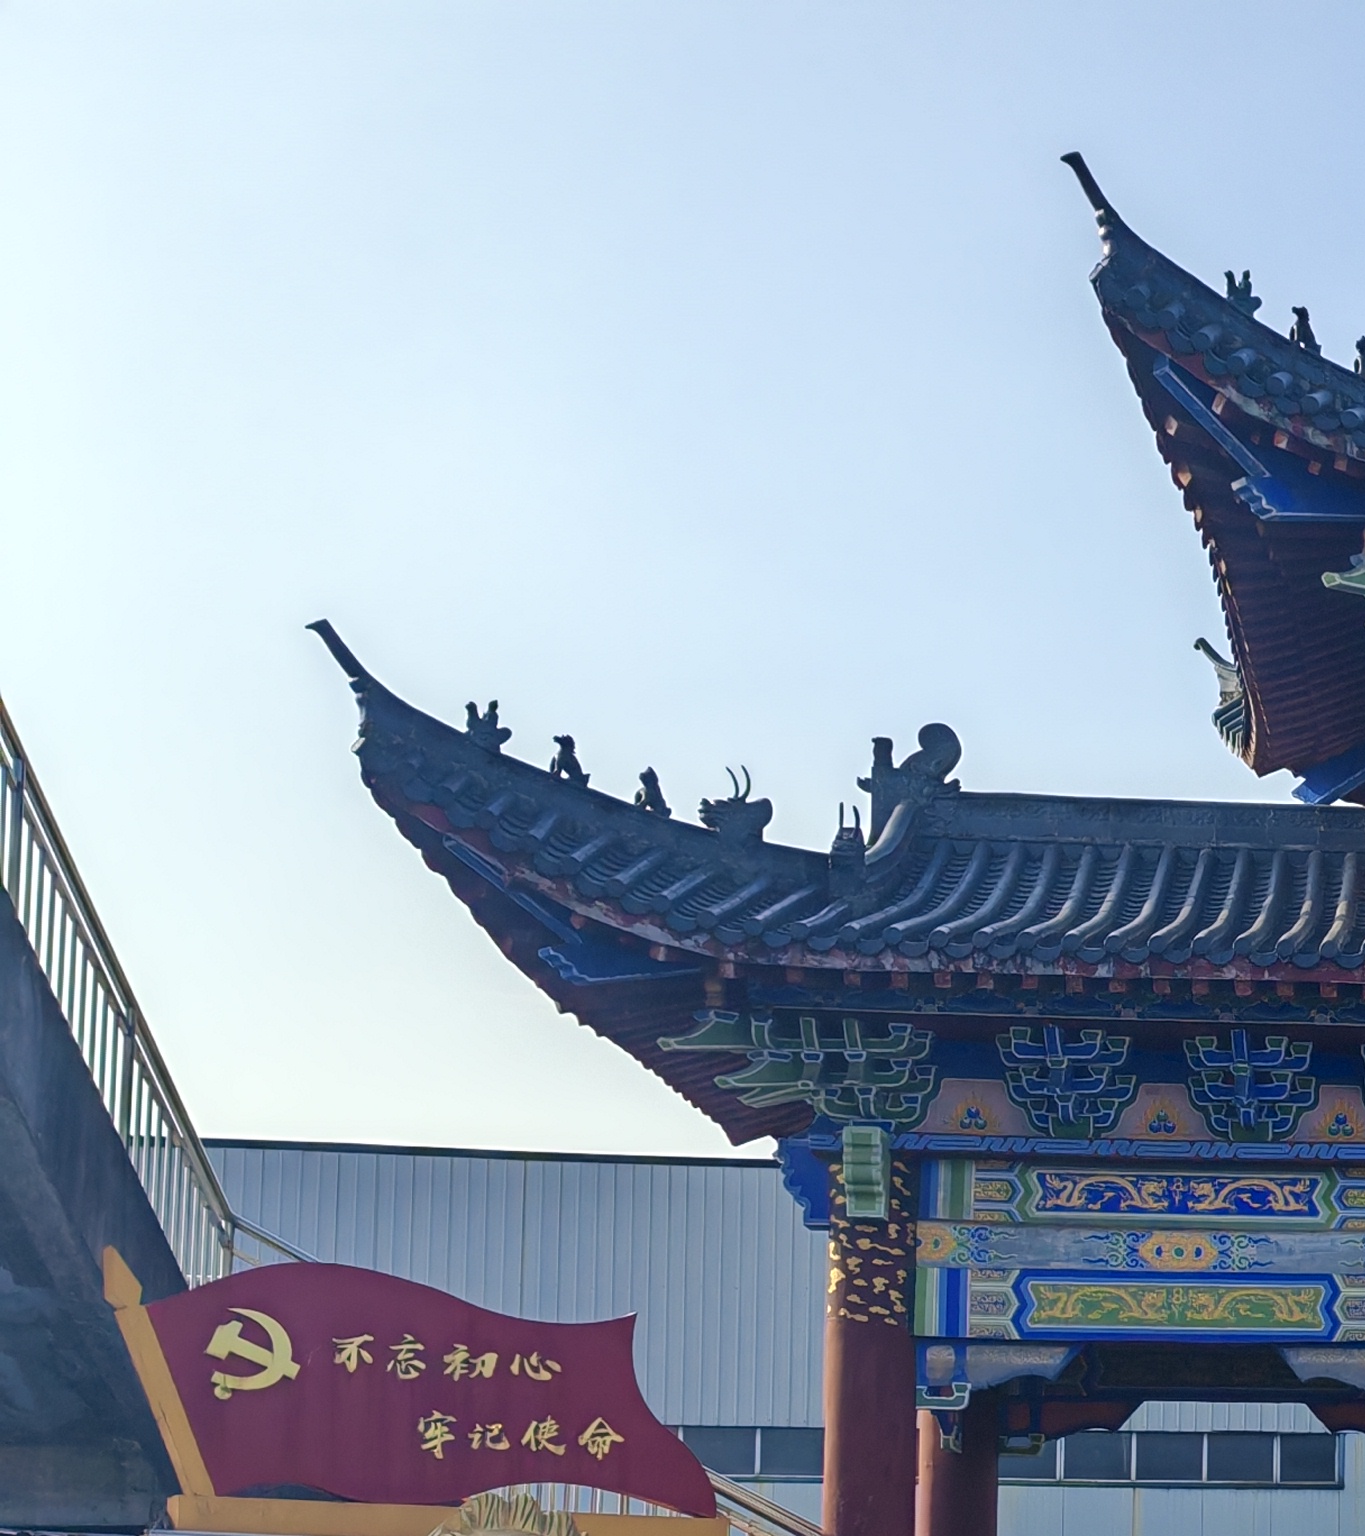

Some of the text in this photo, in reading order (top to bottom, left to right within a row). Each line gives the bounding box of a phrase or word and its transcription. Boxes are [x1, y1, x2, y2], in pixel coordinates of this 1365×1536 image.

[331, 1333, 562, 1382] 不忘初心
[417, 1410, 626, 1461] 牢记使命
